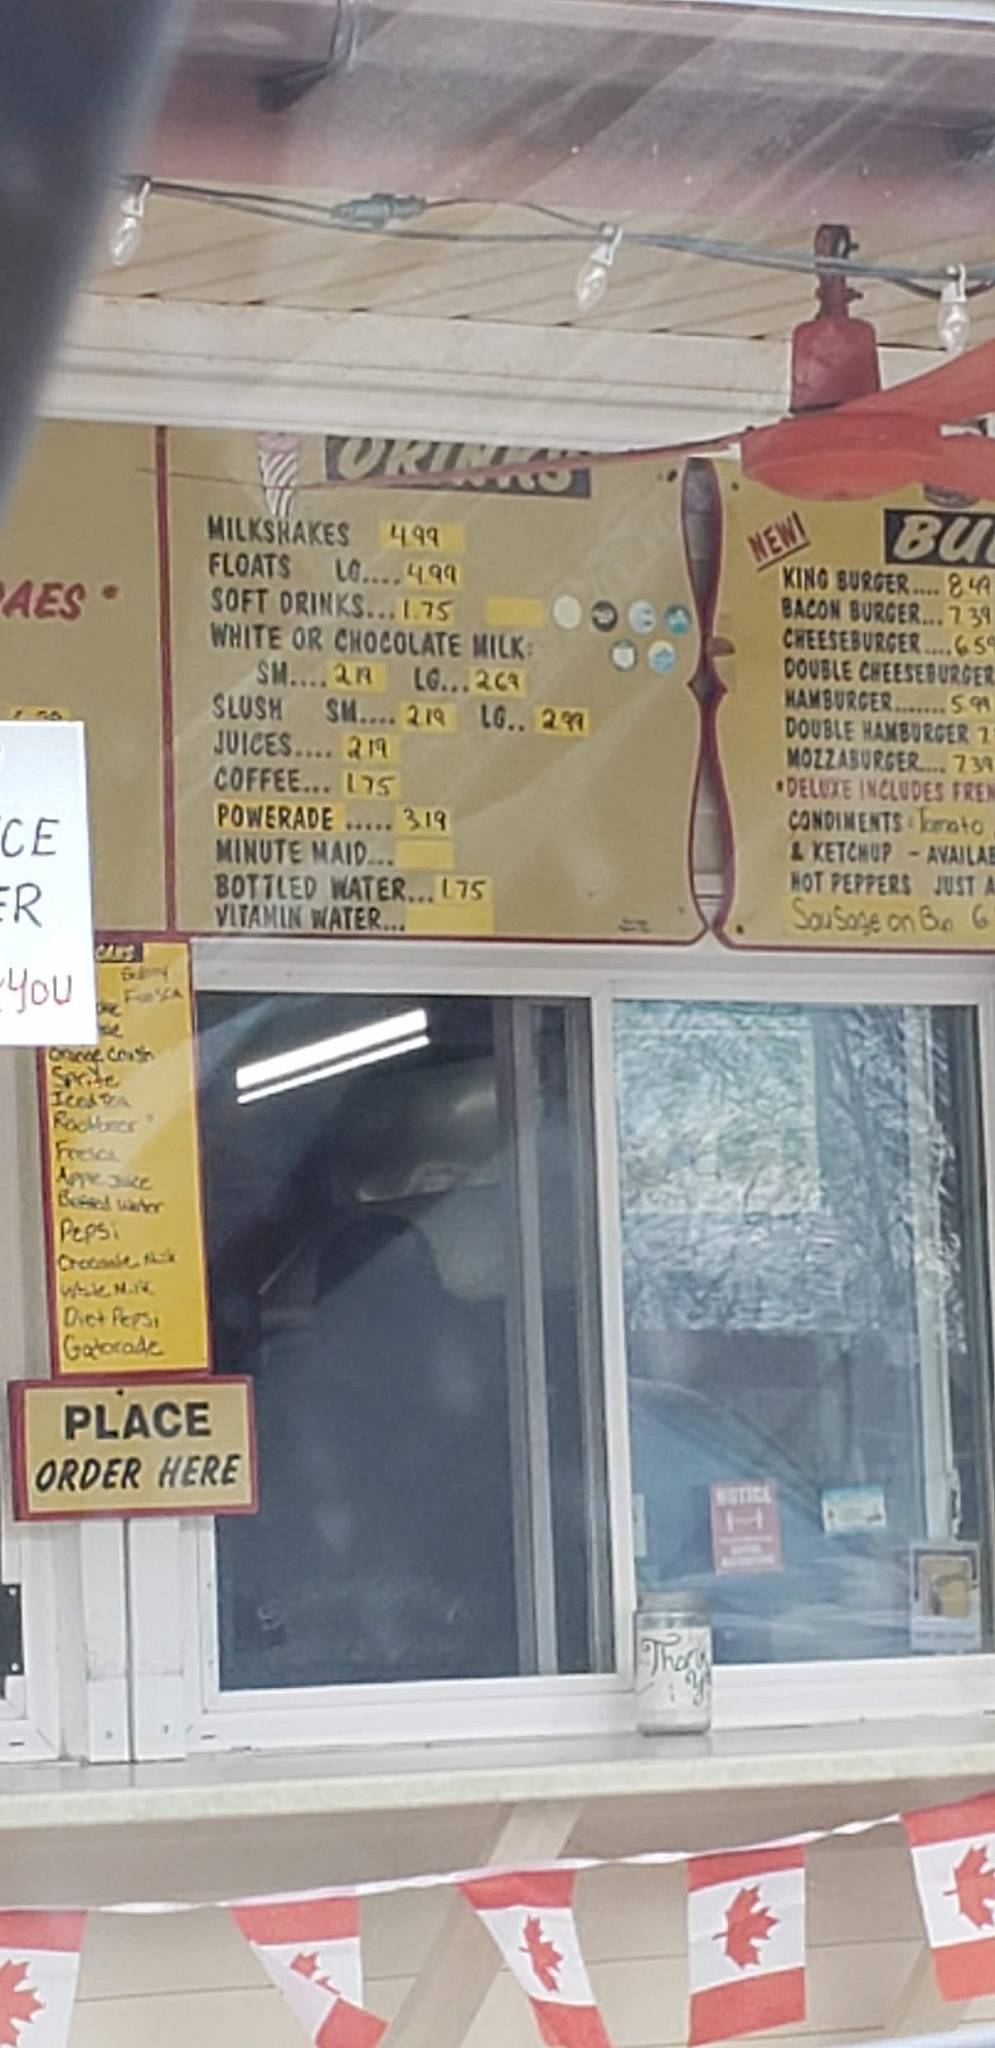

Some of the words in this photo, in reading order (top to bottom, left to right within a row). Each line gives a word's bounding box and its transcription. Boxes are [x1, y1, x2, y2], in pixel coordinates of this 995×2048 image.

[206, 514, 350, 546] MILKSHAKES
[748, 509, 807, 563] NEW!
[207, 552, 291, 579] FLOATS
[782, 566, 829, 591] KING
[210, 586, 269, 614] SOFT
[781, 597, 841, 621] BACON
[210, 621, 283, 650] WHITE
[292, 627, 323, 651] OR
[334, 630, 461, 658] CHOCOLATE
[783, 656, 853, 681] DOUBLE
[858, 661, 995, 686] CHEESEBURGER
[212, 692, 282, 720] SLUSH
[786, 717, 853, 741] DOUBLE
[863, 721, 969, 745] HAMBURGER
[860, 781, 943, 801] INCLUDES
[217, 803, 334, 831] POWERADE
[215, 839, 303, 864] MINUTE
[813, 841, 893, 864] KETCHUP
[215, 874, 317, 900] BOTTLED
[790, 872, 825, 893] HOT
[831, 873, 912, 896] PEPPERS
[934, 875, 975, 897] JUST
[215, 903, 300, 928] VITAMIN
[887, 914, 916, 932] on
[64, 1402, 212, 1440] PLACE
[35, 1456, 142, 1494] ORDER
[158, 1454, 241, 1489] HERE
